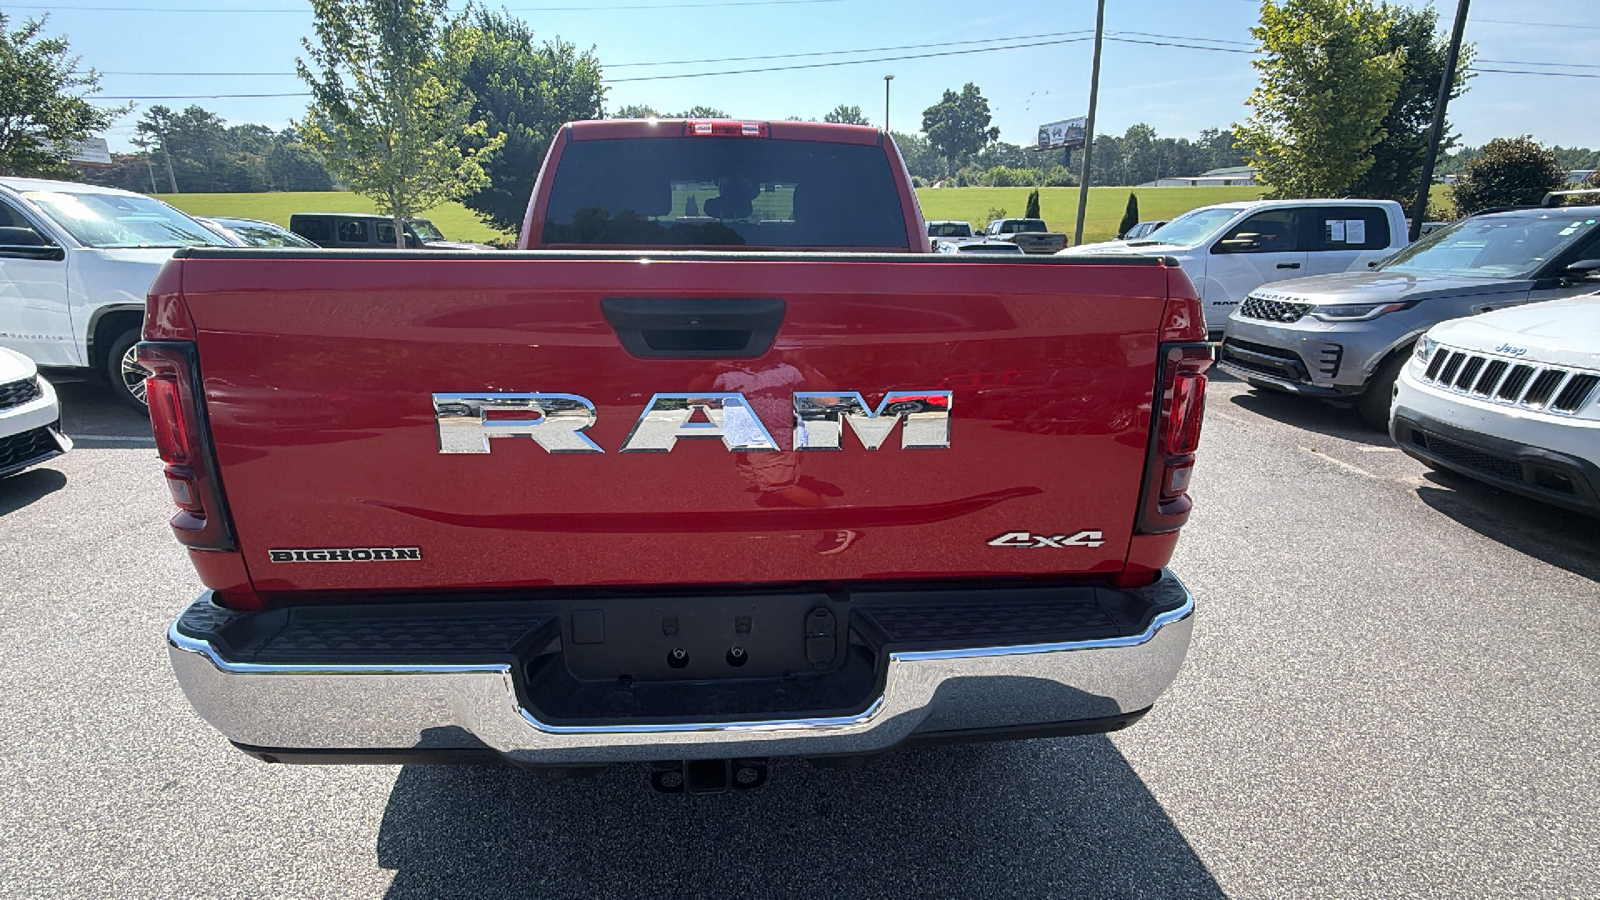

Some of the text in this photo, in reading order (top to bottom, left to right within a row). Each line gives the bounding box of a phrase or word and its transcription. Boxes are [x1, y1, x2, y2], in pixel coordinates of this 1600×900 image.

[1254, 293, 1308, 301] DISCOVERY
[1496, 343, 1527, 357] Jeep
[432, 389, 954, 454] RAM
[987, 530, 1106, 549] 4x4
[267, 547, 422, 563] BIGHORN
